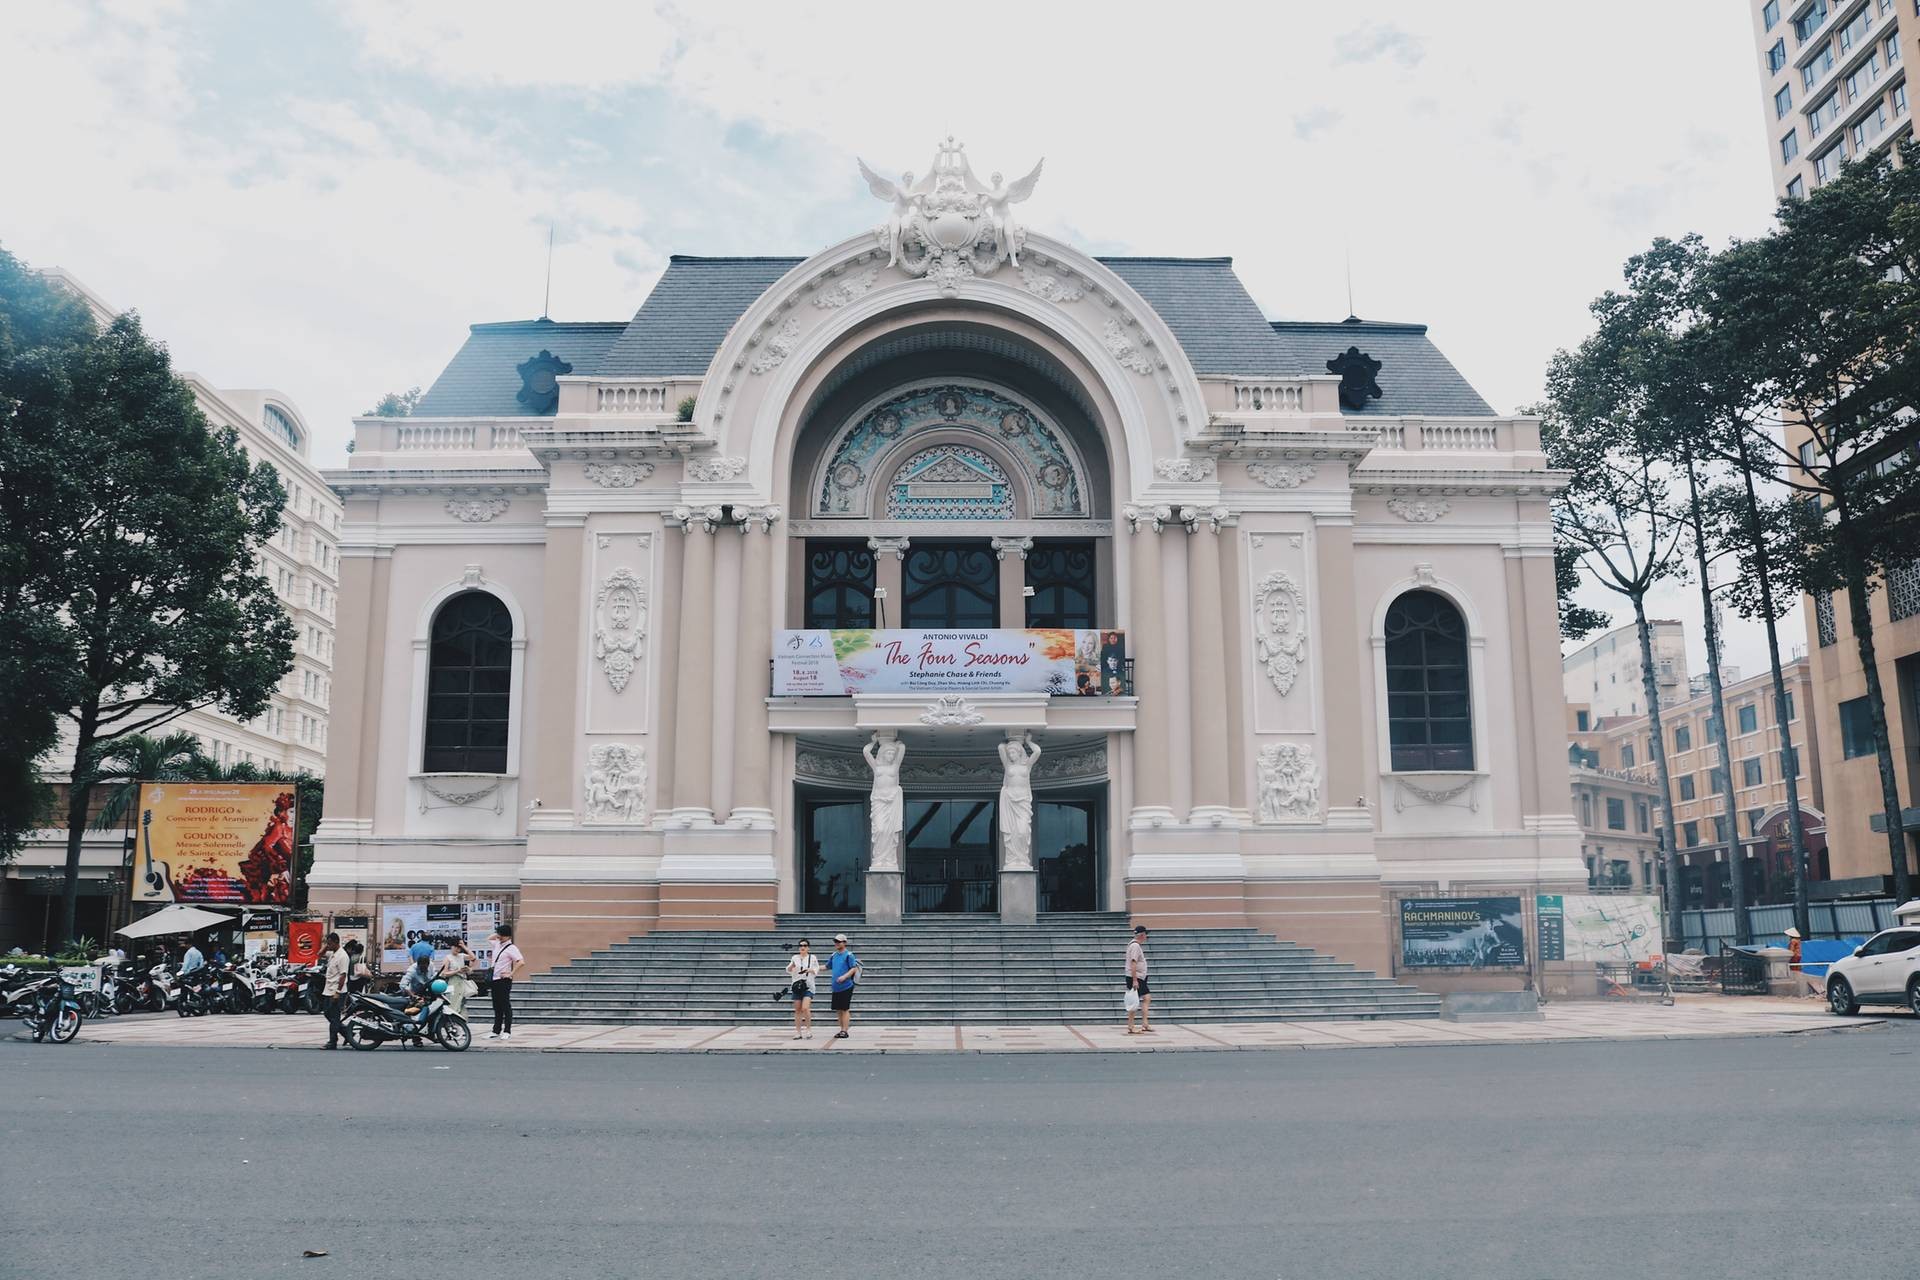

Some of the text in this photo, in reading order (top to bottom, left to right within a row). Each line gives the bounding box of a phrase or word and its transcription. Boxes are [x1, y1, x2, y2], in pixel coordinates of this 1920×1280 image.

[917, 642, 957, 671] Four
[909, 671, 946, 679] Stephanie
[222, 815, 259, 823] Aranjuez
